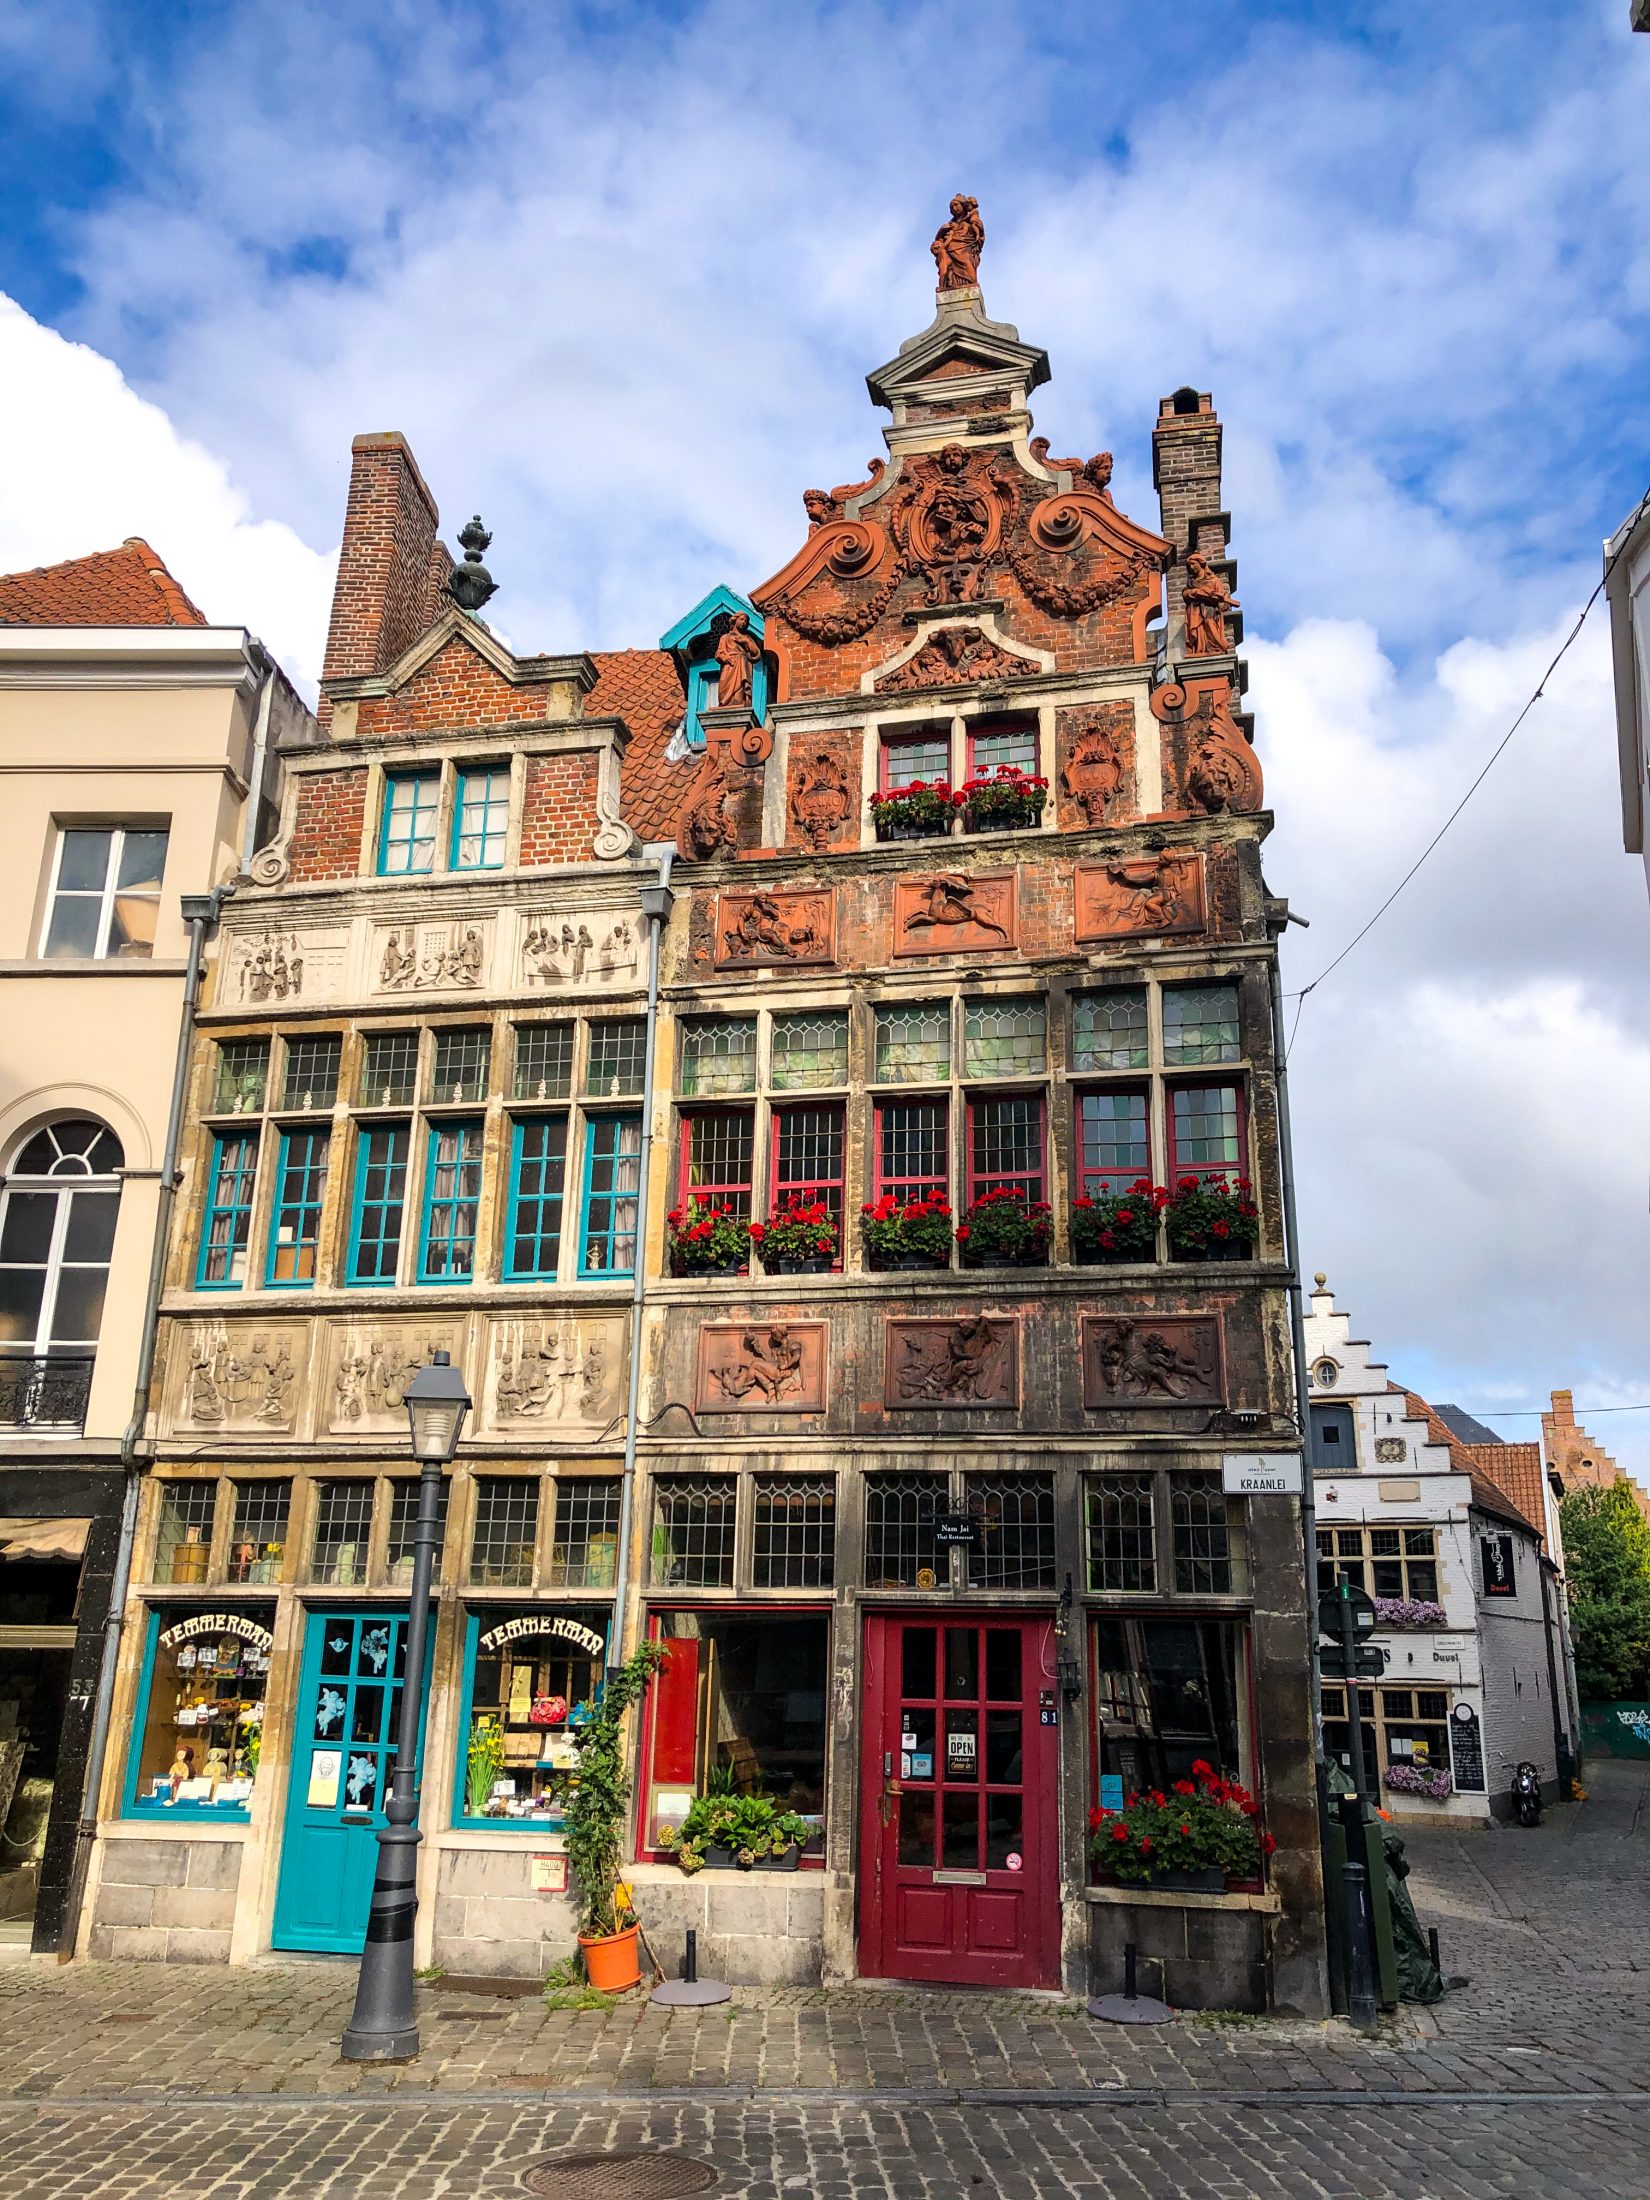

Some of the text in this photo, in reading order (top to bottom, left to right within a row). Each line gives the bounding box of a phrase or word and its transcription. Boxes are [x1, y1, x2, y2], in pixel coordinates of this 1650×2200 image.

[1240, 1479, 1286, 1490] KRAANLEI
[941, 1524, 969, 1533] Nam Jai
[159, 1614, 273, 1651] TEMMERMAN
[480, 1616, 604, 1655] TEMMERMAN
[1432, 1652, 1459, 1662] Duvel
[71, 1679, 95, 1695] 53
[1041, 1711, 1057, 1723] 81
[950, 1741, 973, 1754] OPEN
